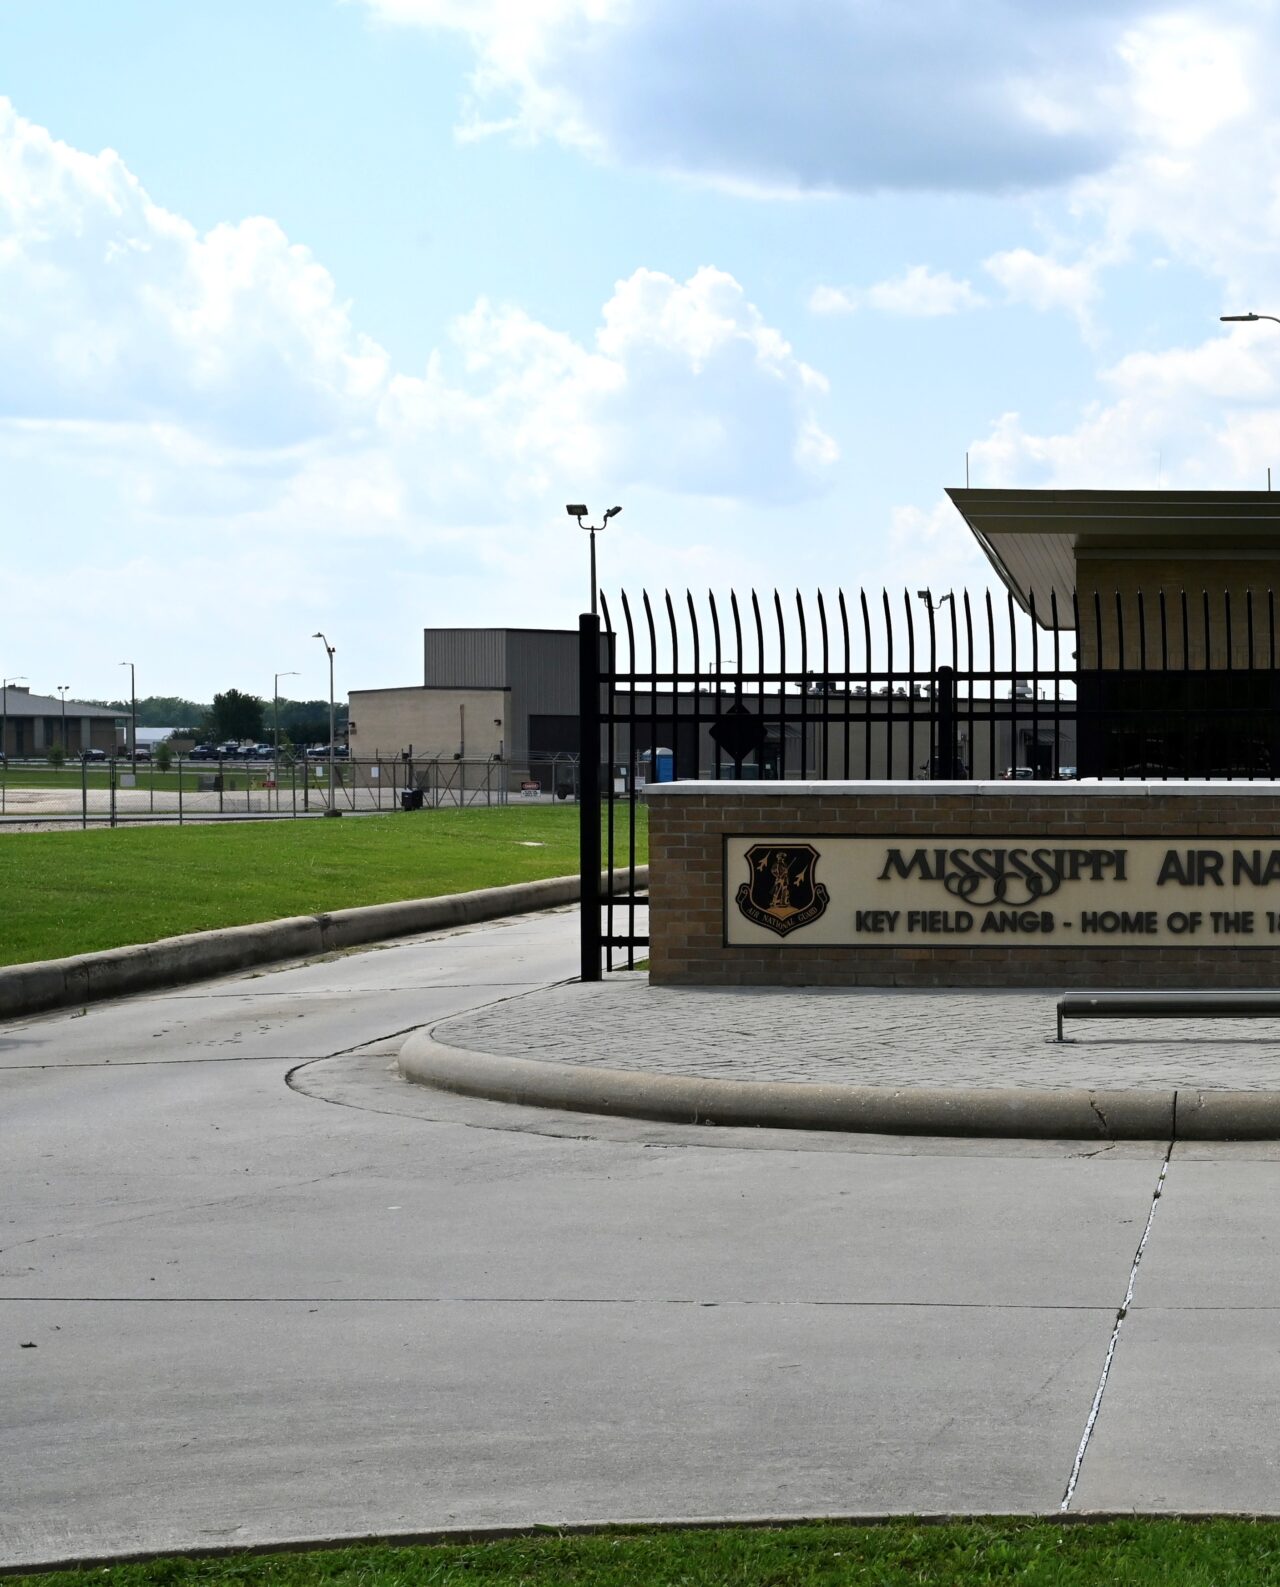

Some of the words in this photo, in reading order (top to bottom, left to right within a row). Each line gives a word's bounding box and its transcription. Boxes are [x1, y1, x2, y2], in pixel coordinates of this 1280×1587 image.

[877, 848, 1128, 907] MISSISSIPPI
[1156, 849, 1225, 888] AIR
[747, 907, 760, 919] AIR
[762, 914, 794, 931] NATIONAL
[799, 907, 818, 921] GUARD
[856, 911, 900, 934] KEY
[907, 911, 974, 934] FIELD
[980, 911, 1055, 934] ANGB
[1081, 911, 1158, 935] HOME
[1166, 911, 1203, 935] OF
[1210, 911, 1254, 935] THE
